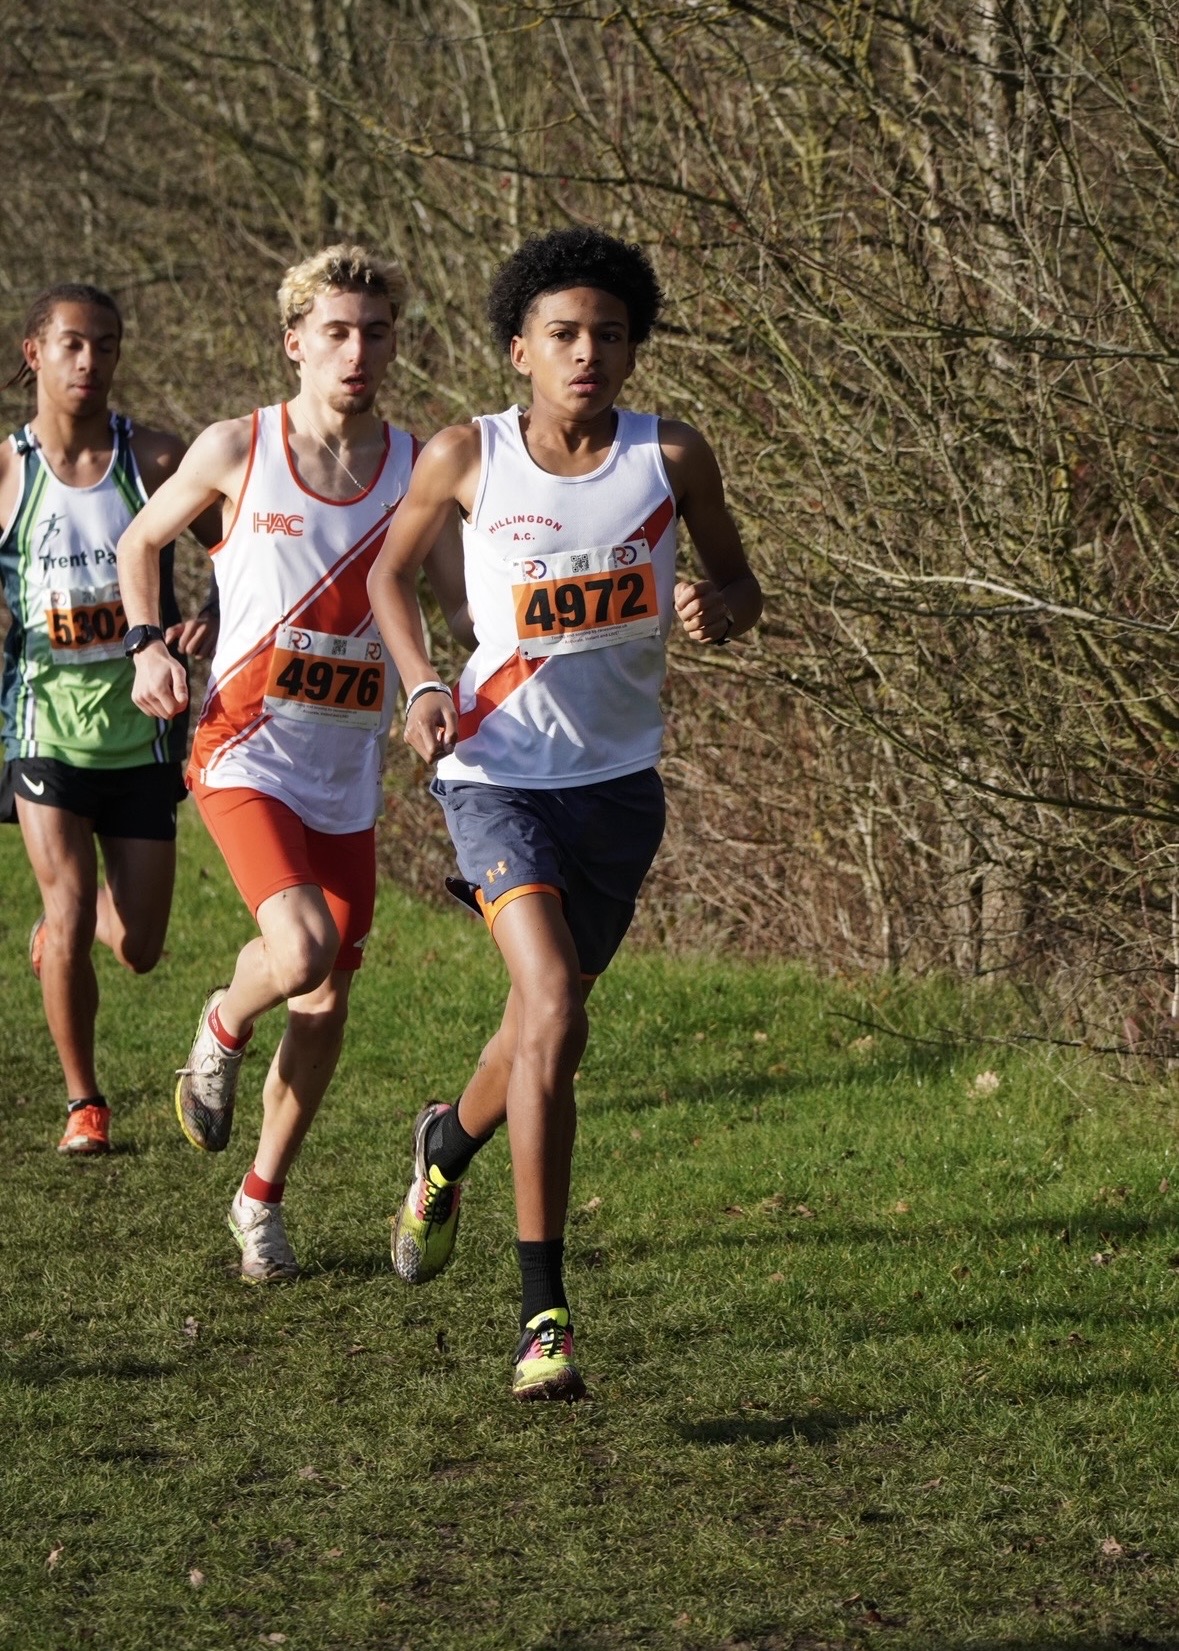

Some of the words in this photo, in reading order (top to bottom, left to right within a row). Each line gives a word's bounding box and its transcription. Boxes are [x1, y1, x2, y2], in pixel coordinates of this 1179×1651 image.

[253, 512, 304, 536] HAC
[488, 514, 563, 534] HILLINGDON
[513, 533, 536, 541] A.C.
[39, 552, 88, 571] Trent
[525, 572, 648, 631] 4972
[276, 656, 381, 707] 4976
